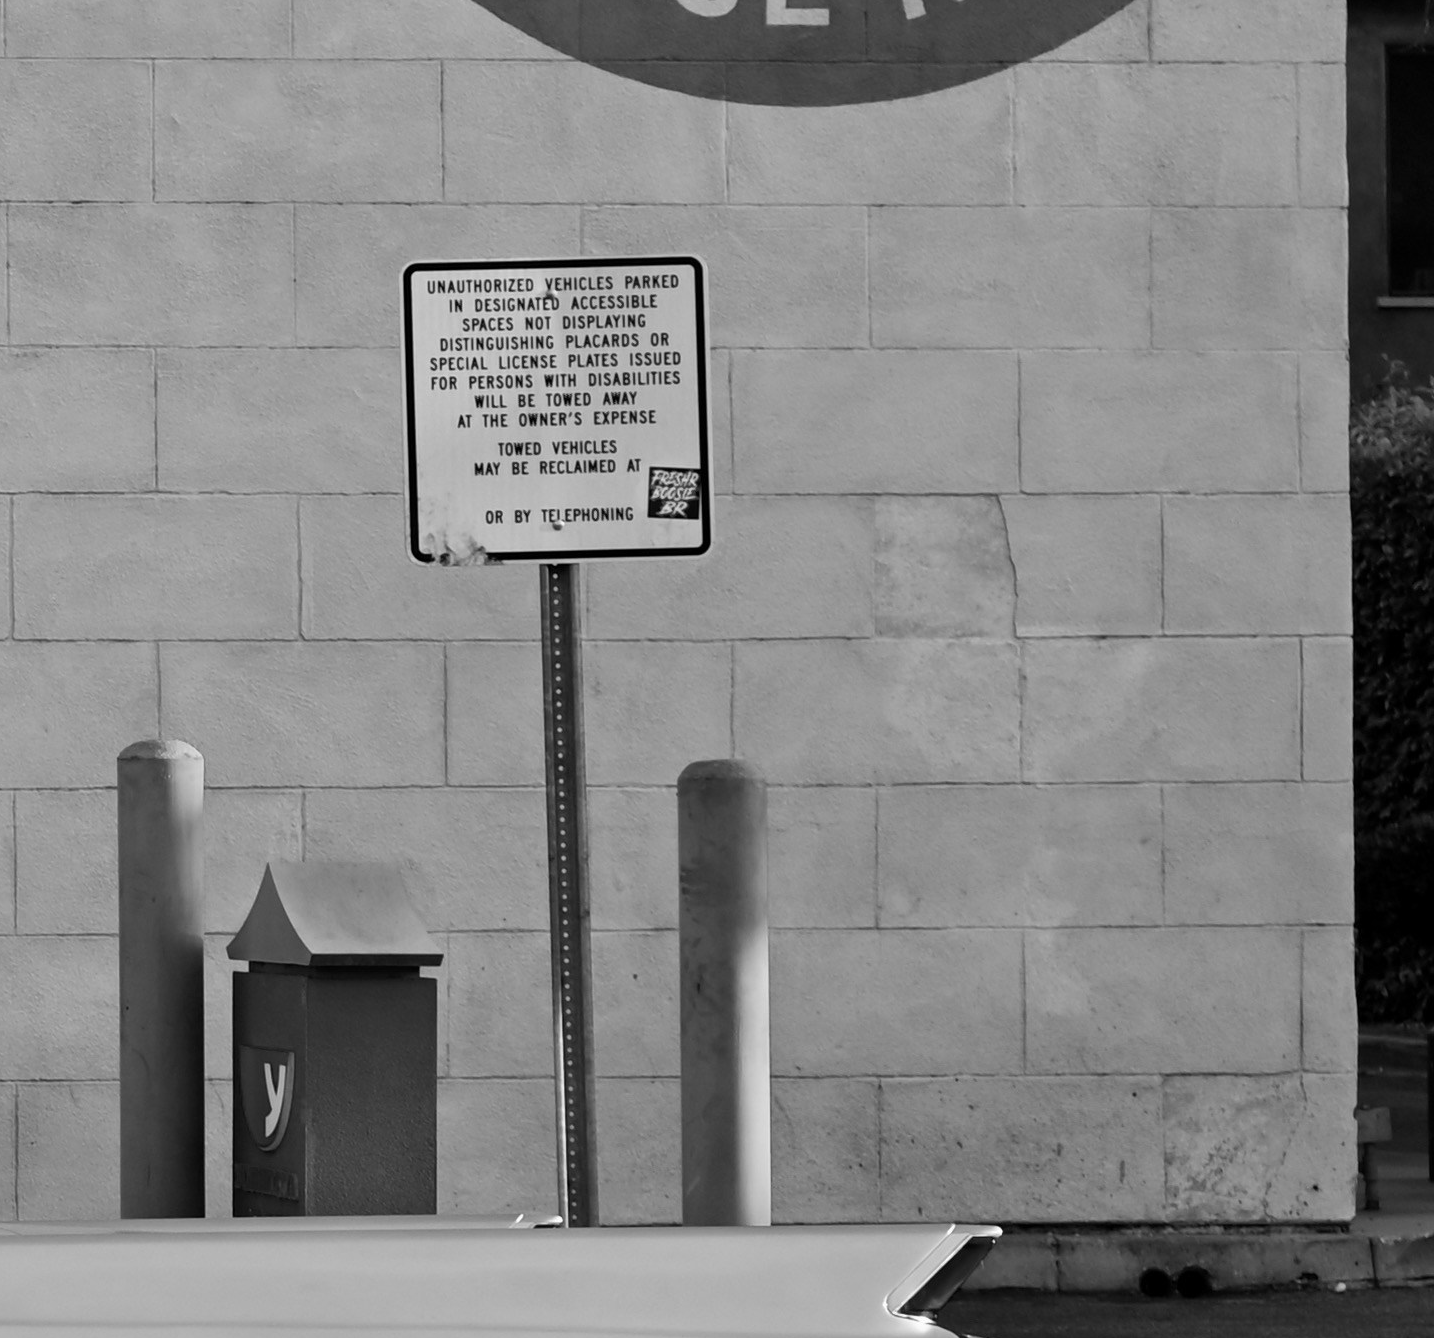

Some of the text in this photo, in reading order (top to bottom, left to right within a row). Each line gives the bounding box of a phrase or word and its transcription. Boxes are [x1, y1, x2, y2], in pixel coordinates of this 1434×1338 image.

[427, 274, 679, 295] UNAUTHORIZED VEHICLES PARKED
[449, 294, 658, 313] IN DESIGNATED ACCESSIBLE
[462, 313, 646, 332] SPACES NOT DISPLAYING
[440, 332, 669, 352] DISTINGUISHING PLACARDS OR
[430, 351, 681, 372] SPECIAL LICENSE PLATES ISSUED
[431, 370, 681, 391] FOR PERSONS WITH DISABILITIES
[474, 391, 637, 409] WILL BE TOWED AWAY
[457, 409, 657, 428] AT THE OWNER'S EXPENSE
[498, 439, 618, 457] TOWED VEHICLES
[474, 458, 641, 476] MAY BE RECLAIMED AT
[485, 506, 634, 525] OR BY TELEPHONING
